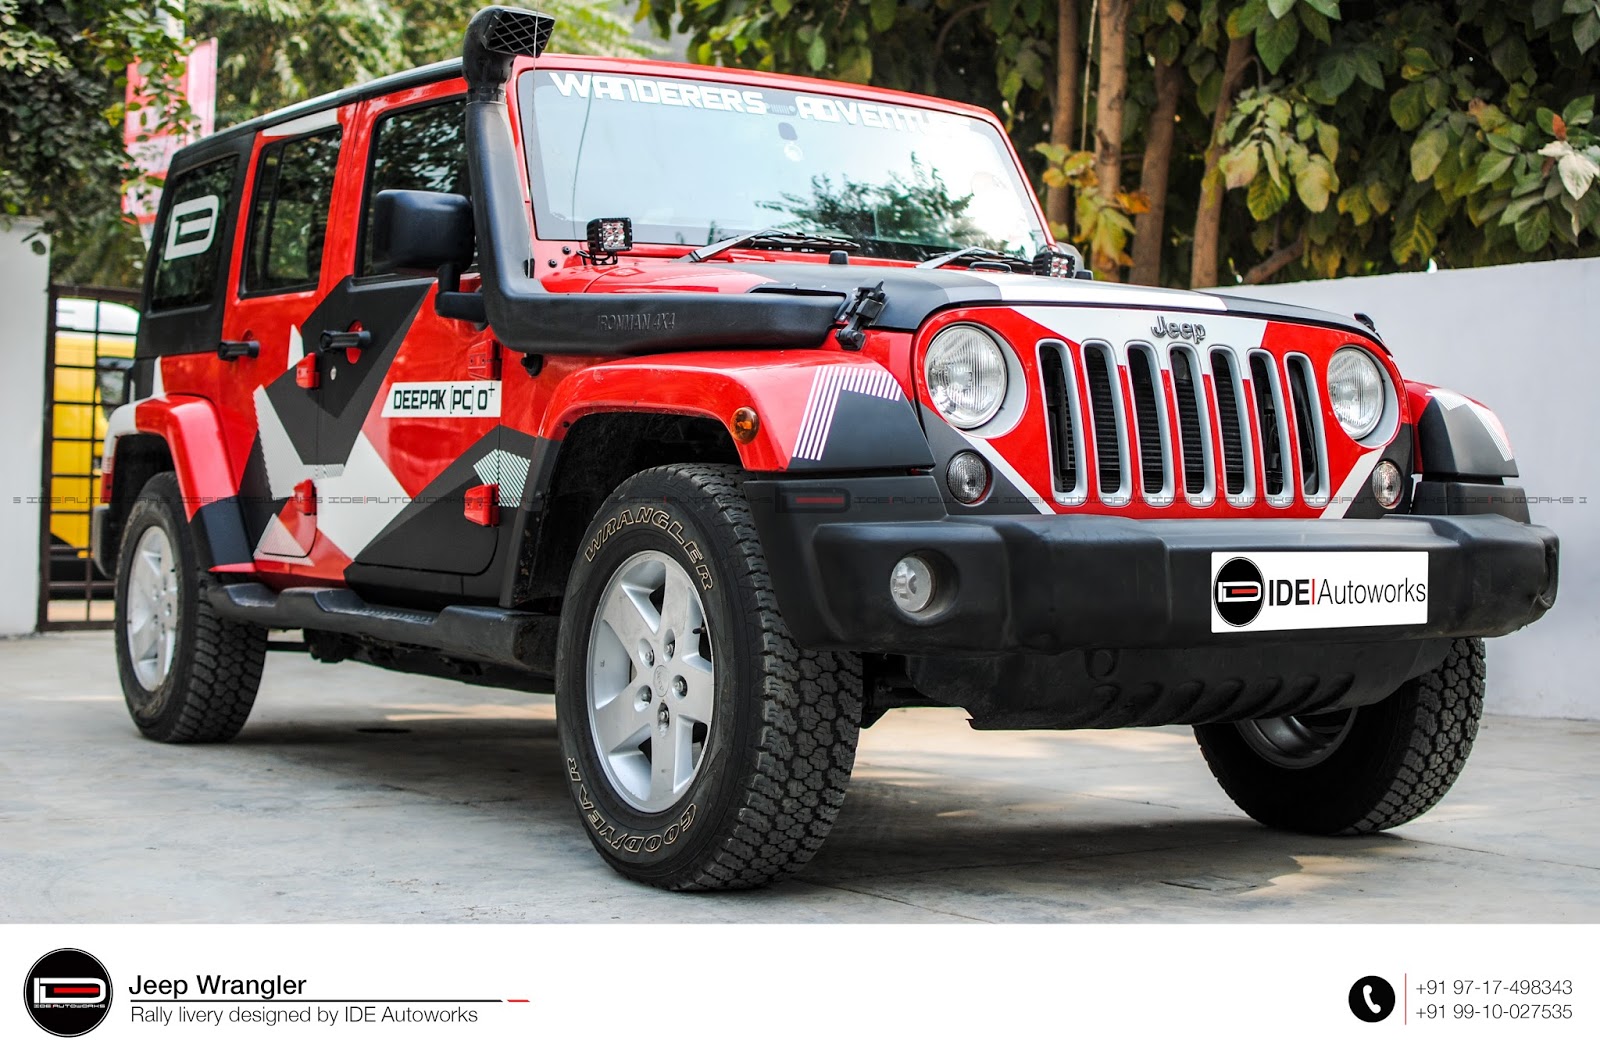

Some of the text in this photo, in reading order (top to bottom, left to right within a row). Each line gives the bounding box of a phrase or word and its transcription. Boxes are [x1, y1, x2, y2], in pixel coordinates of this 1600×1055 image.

[549, 72, 971, 137] WANDERERS ADVENTU
[1150, 315, 1207, 345] Jeep
[393, 389, 447, 410] DEEPAK
[585, 507, 713, 590] WRANGLER
[567, 757, 697, 853] GOODYEAR
